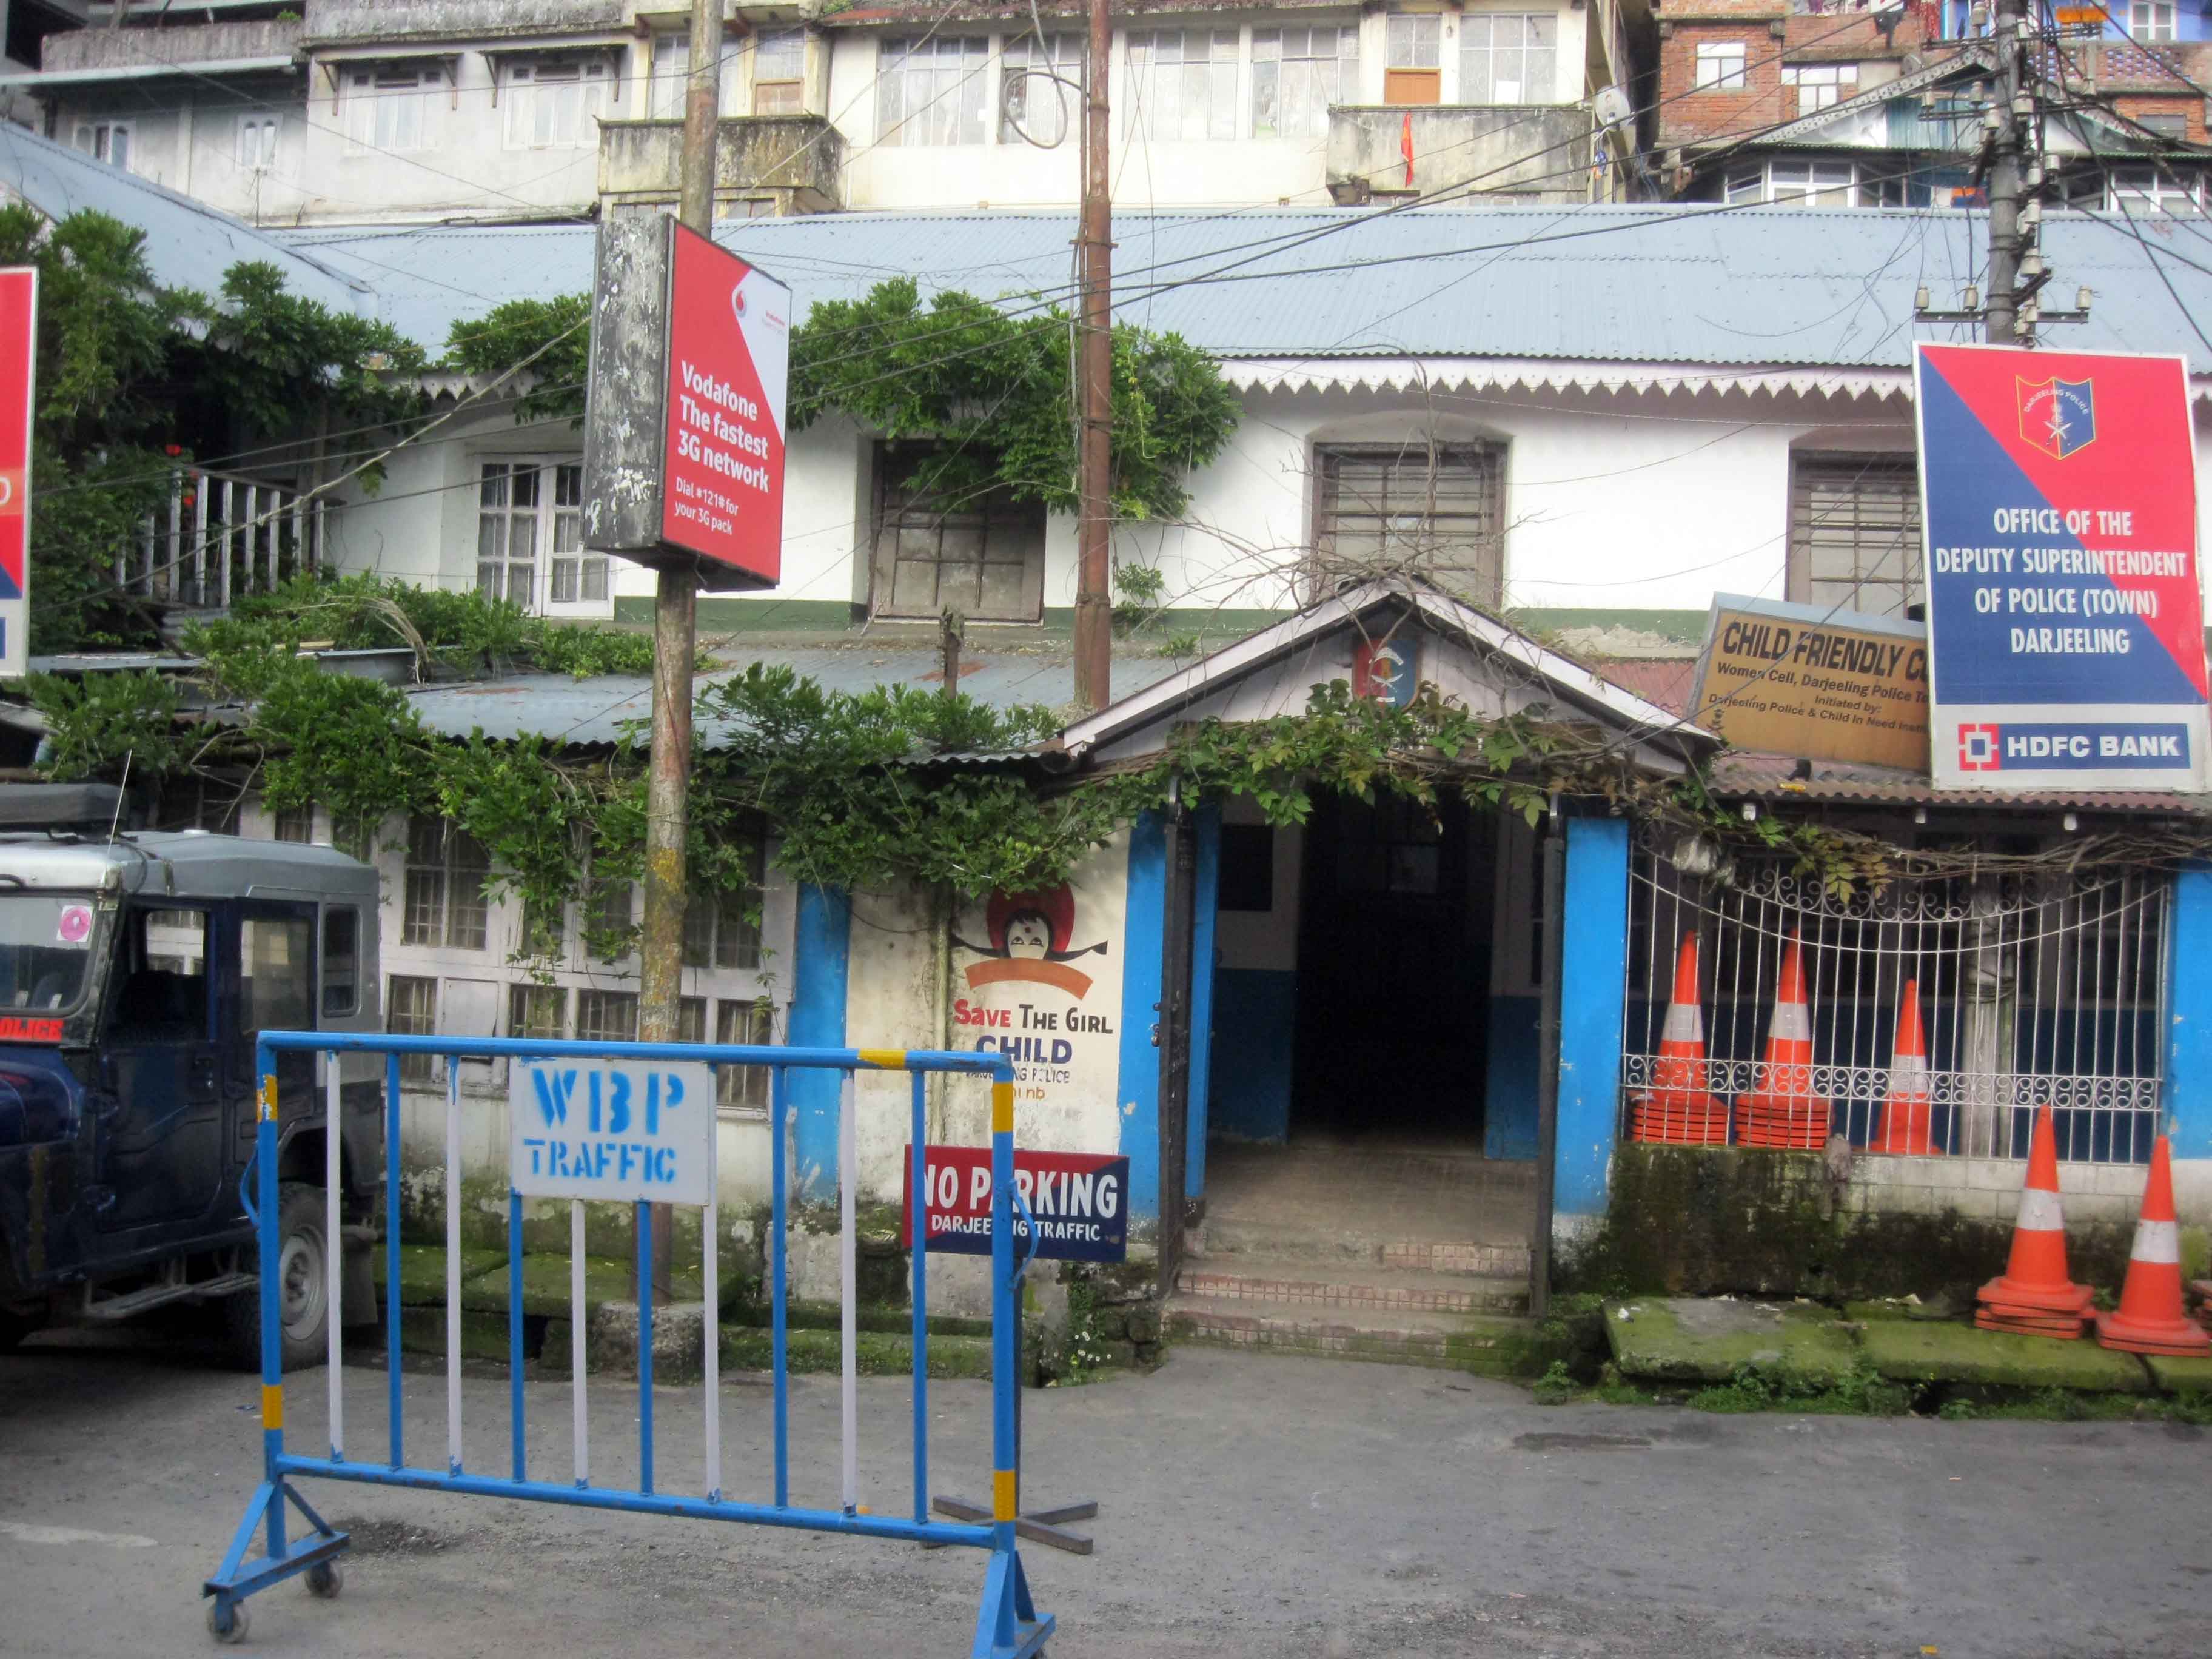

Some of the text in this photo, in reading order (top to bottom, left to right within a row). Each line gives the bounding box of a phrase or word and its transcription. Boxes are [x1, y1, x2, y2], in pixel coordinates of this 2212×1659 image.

[682, 360, 757, 422] Vodafone
[2065, 391, 2090, 415] POLICE
[680, 394, 768, 460] The fastest
[678, 428, 769, 493] 3G network
[676, 476, 694, 498] Dial
[726, 498, 739, 516] for
[674, 501, 732, 536] your 3G pack
[1993, 508, 2133, 536] OFFICE OF THE
[1936, 548, 2187, 577] DEPUTY SUPERINTENDENT
[1974, 588, 2159, 618] OF POLICE (TOWN)
[1722, 621, 1791, 661] CHILD
[1792, 630, 1906, 679] FRIENDLY
[2011, 628, 2130, 654] DARJEELING
[1717, 661, 1766, 680] Women
[1769, 669, 1797, 687] Cell,
[1801, 674, 1869, 697] Darjeeling
[1872, 683, 1912, 702] Police
[1708, 693, 1767, 712] Darjeeling
[1769, 701, 1805, 716] Police
[1808, 708, 1816, 717] &
[1820, 709, 1850, 723] Child
[1852, 713, 1863, 724] In
[1866, 716, 1897, 729] Need
[1815, 695, 1862, 711] Initiated
[2007, 736, 2182, 757] HDFC BANK
[1019, 1004, 1058, 1030] THE
[1065, 1007, 1113, 1034] GIRL
[976, 1034, 1073, 1064] CHILD
[523, 1138, 677, 1182] TRAFFIC
[970, 1166, 1118, 1219] PRKING
[1034, 1221, 1101, 1241] TRAFFIC
